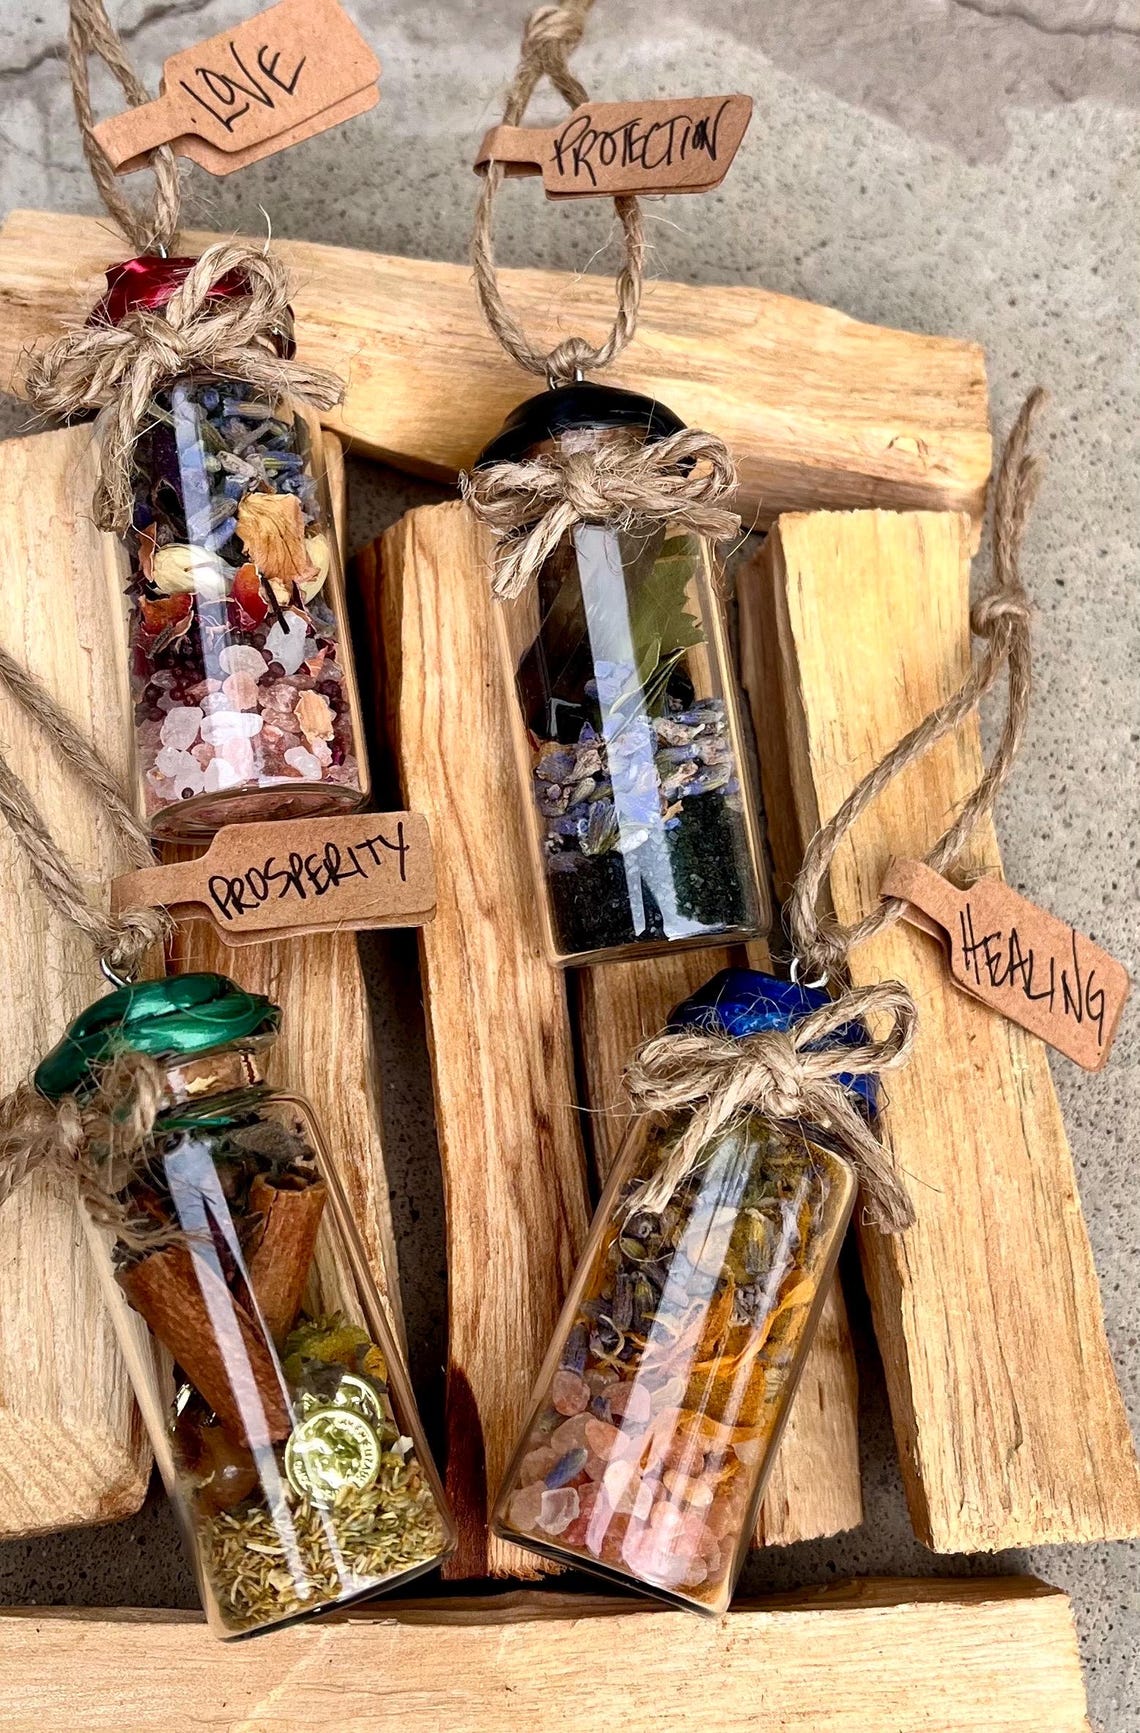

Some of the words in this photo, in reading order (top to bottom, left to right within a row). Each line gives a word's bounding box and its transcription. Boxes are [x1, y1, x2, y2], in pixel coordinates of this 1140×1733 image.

[180, 41, 307, 132] LOVE
[208, 821, 410, 920] PROSPERITY
[960, 903, 1105, 1046] HEALING
